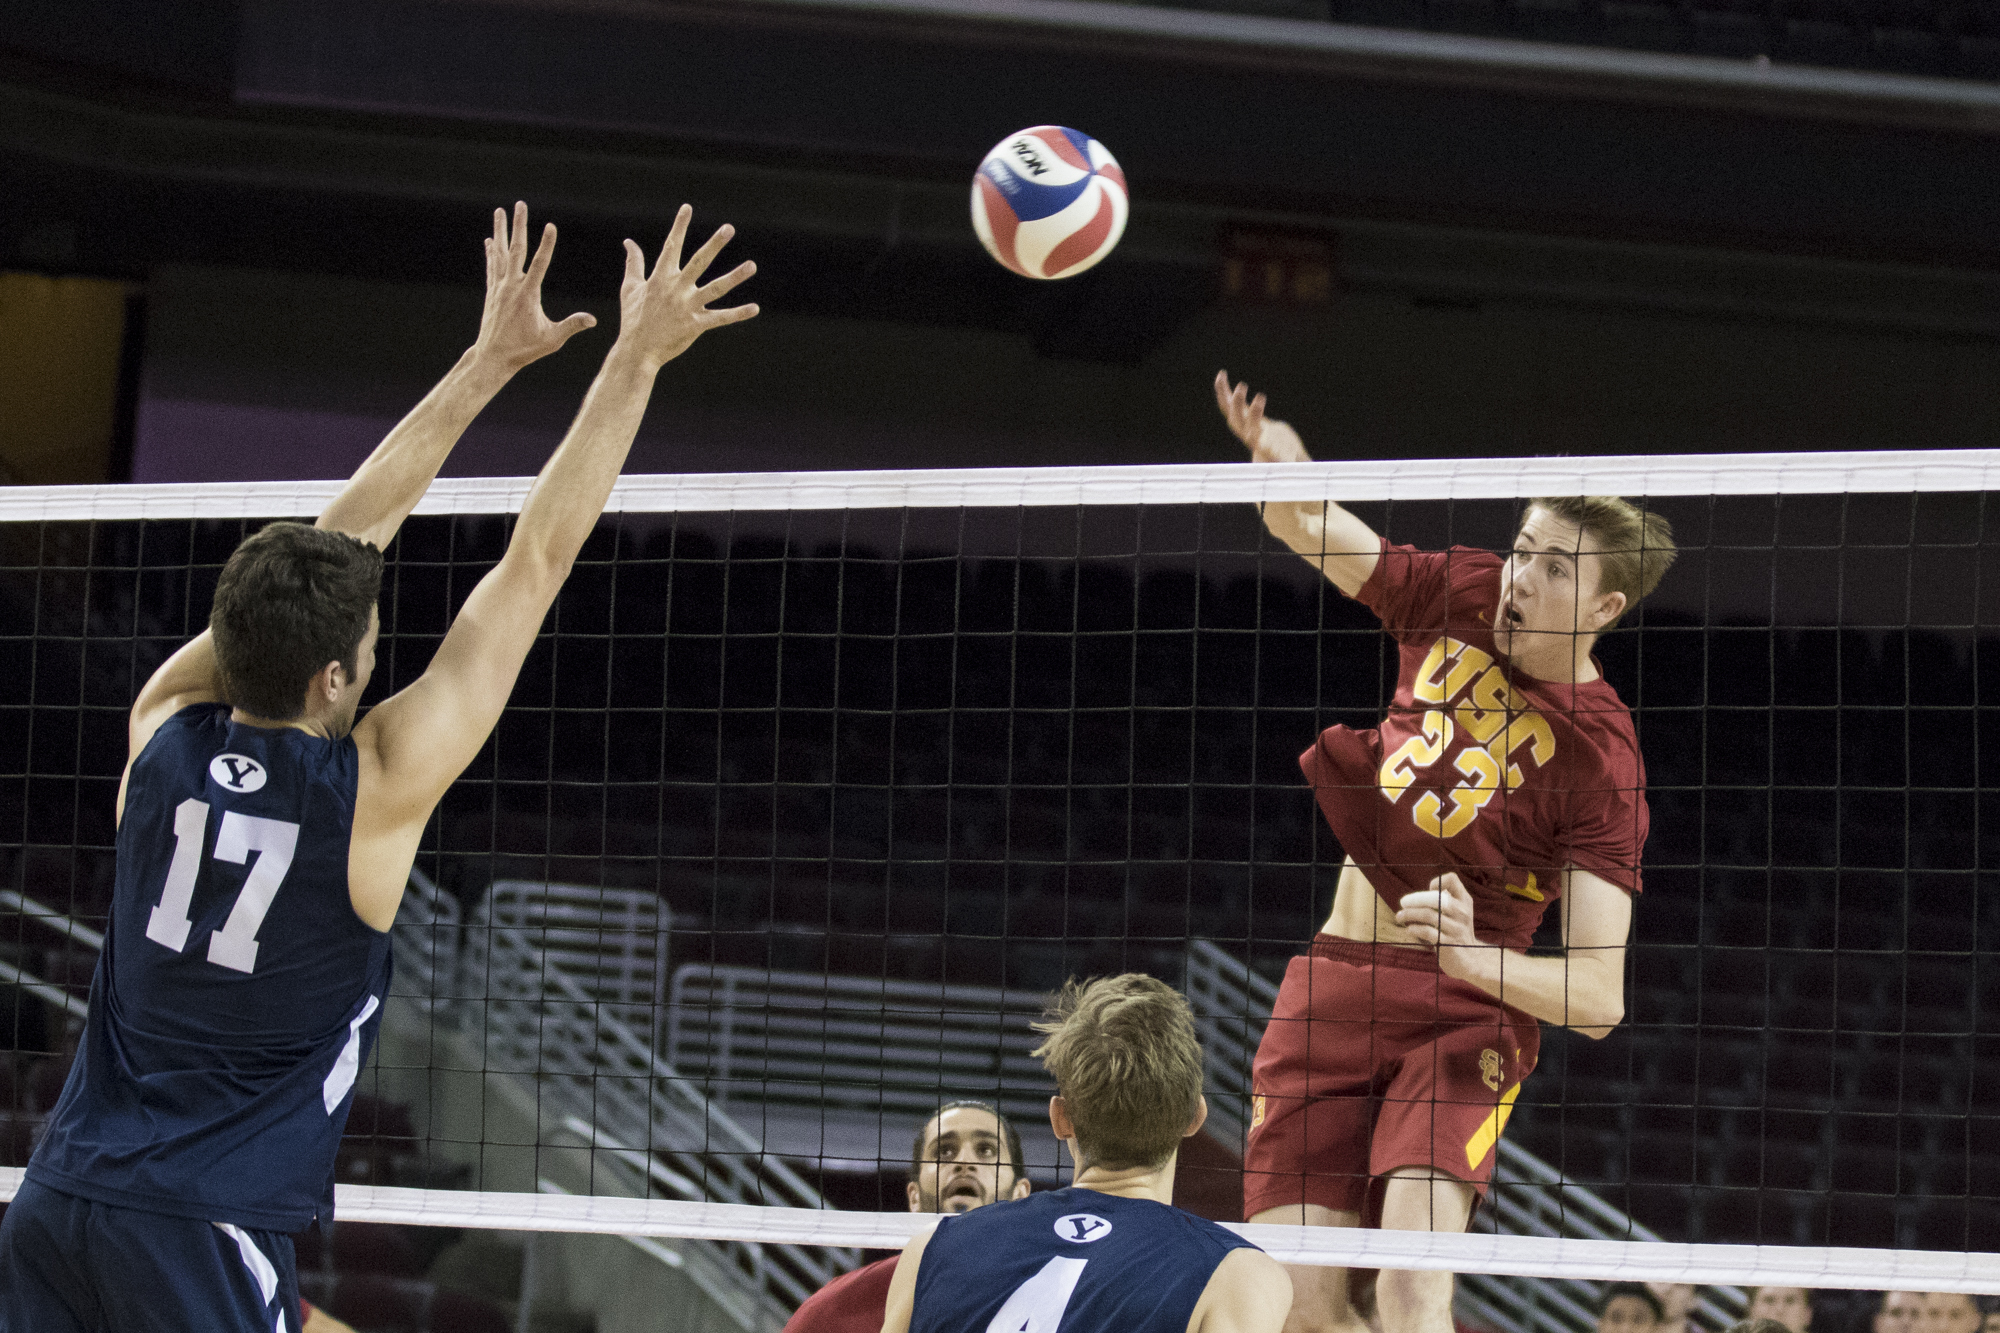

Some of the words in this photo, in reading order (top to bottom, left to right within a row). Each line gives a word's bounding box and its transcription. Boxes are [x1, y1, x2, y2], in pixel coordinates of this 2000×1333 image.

[220, 757, 259, 789] Y
[1379, 708, 1501, 839] 23
[1413, 635, 1556, 795] USC
[145, 797, 300, 974] 17
[1067, 1216, 1106, 1241] Y
